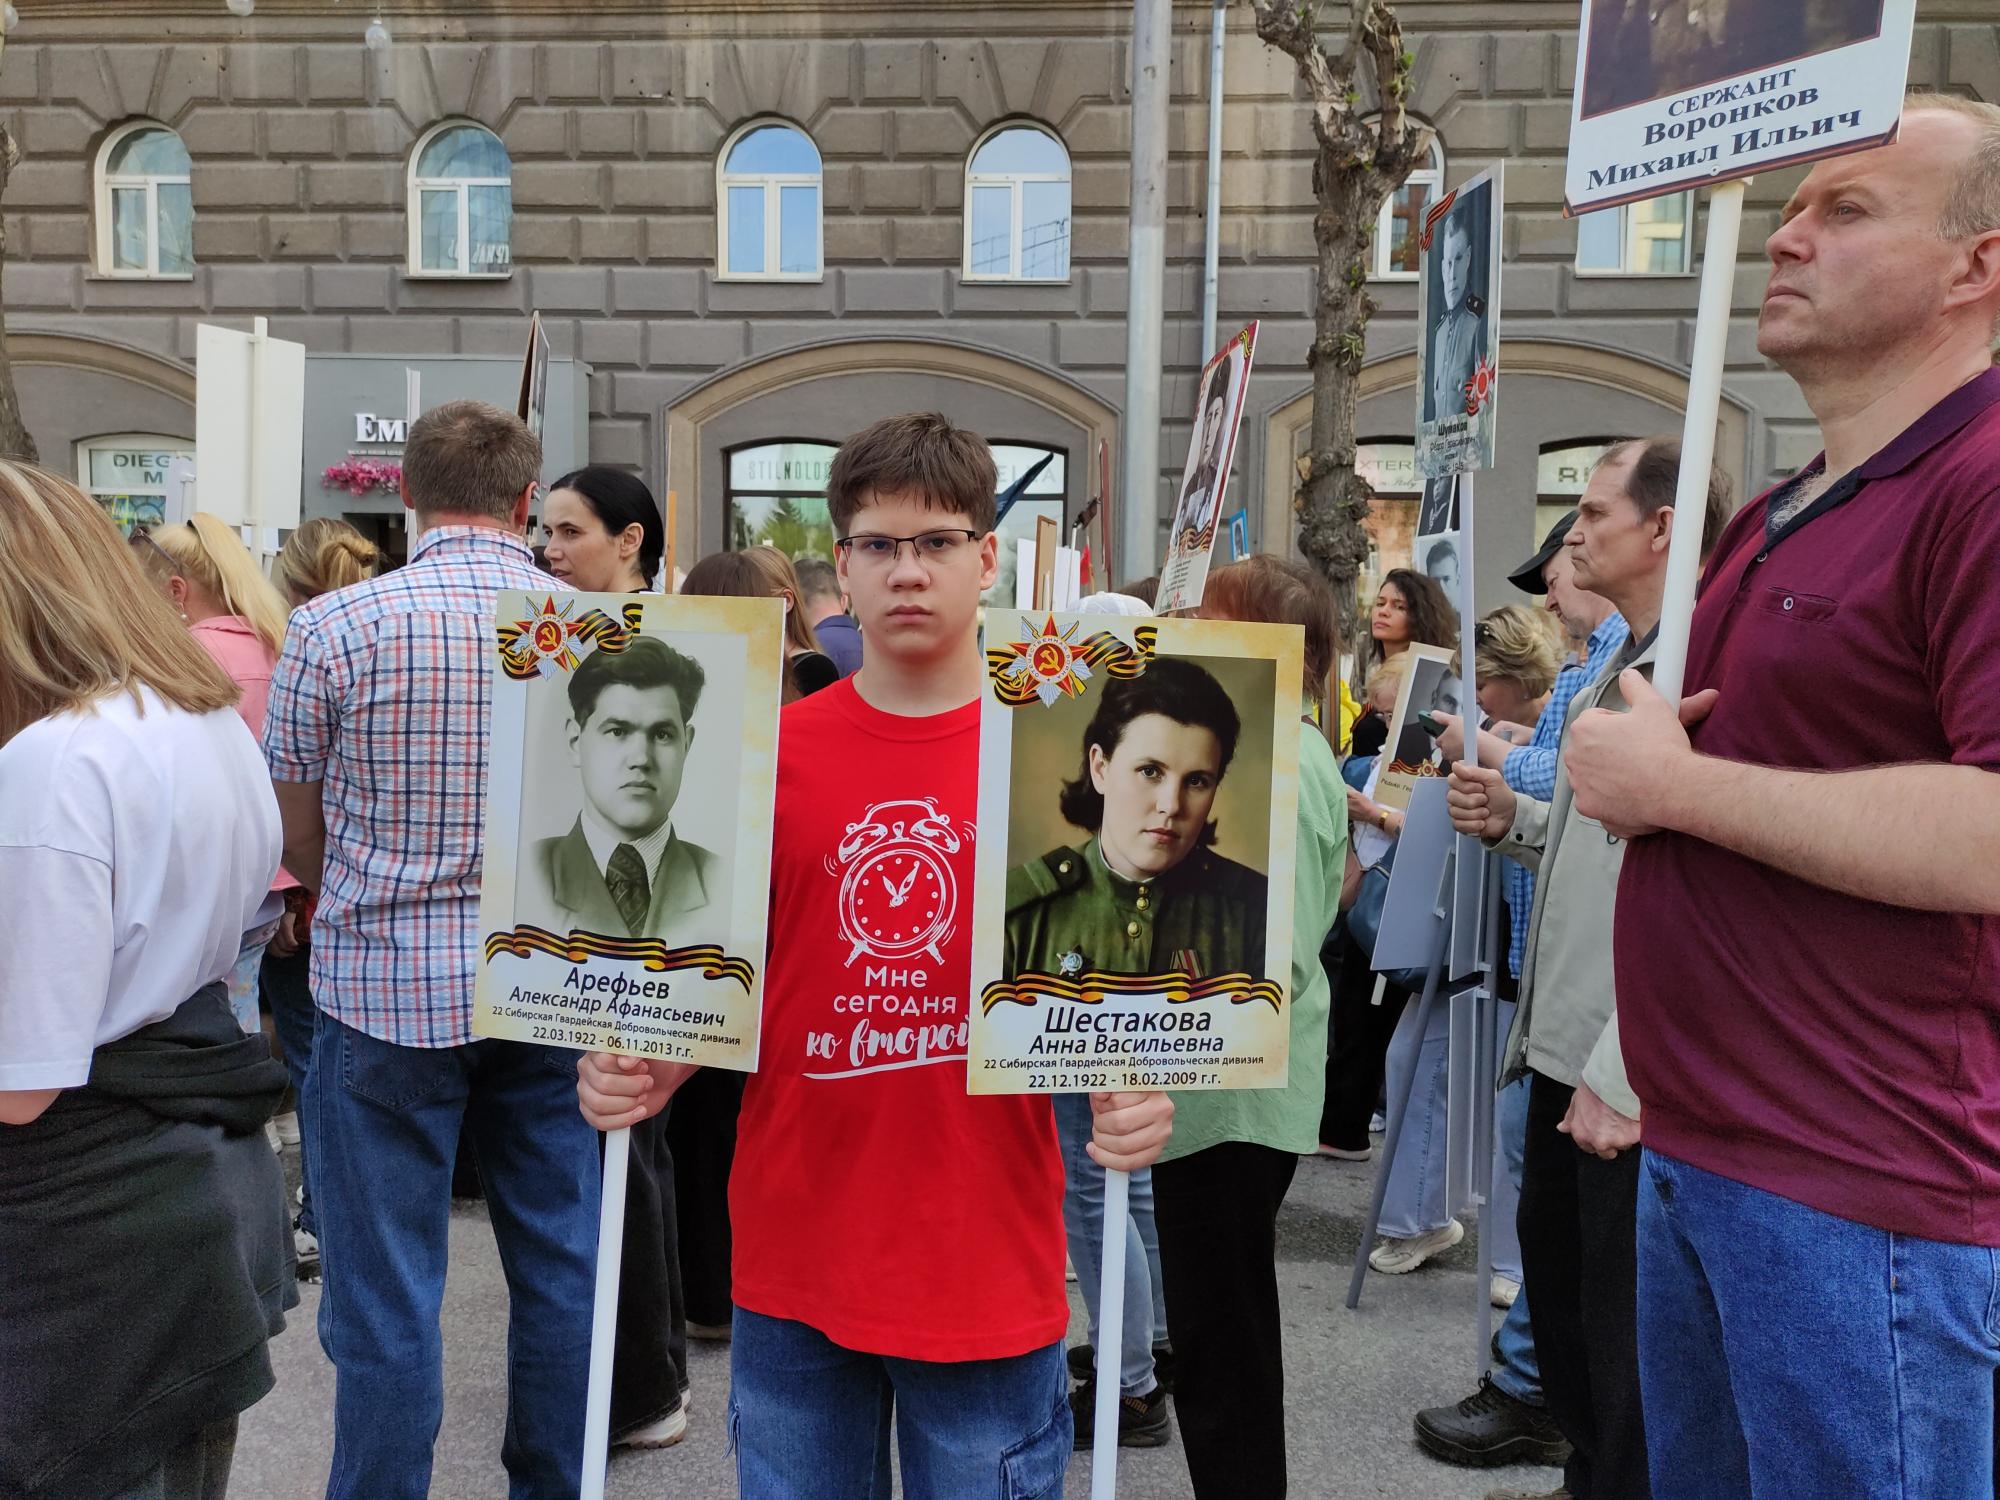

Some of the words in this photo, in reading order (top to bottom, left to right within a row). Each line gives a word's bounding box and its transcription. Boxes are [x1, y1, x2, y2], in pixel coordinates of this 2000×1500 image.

[1667, 68, 1797, 118] СЕРЖАНТ
[1641, 86, 1819, 147] Воронков
[1586, 143, 1719, 191] Михаил
[1726, 108, 1863, 156] Ильич
[113, 454, 192, 468] DIEG
[564, 967, 670, 1000] Арефьев
[865, 965, 928, 988] Мне
[509, 986, 602, 1016] Александр
[606, 995, 725, 1027] Афанасьевич
[833, 994, 957, 1017] сегодня
[492, 1006, 503, 1016] 22
[505, 1007, 553, 1022] Сибирская
[556, 1013, 613, 1029] Гвардейская
[614, 1020, 699, 1041] Добровольческая
[700, 1033, 741, 1046] дивизия
[1045, 1006, 1212, 1034] Шестакова
[533, 1026, 596, 1046] 22.03.1922
[607, 1036, 672, 1056] 06.11.2013
[675, 1047, 694, 1058] г.г.
[806, 1031, 842, 1059] ко
[1029, 1034, 1086, 1055] Анна
[1094, 1033, 1224, 1054] Васильевна
[984, 1059, 997, 1069] 22
[999, 1058, 1057, 1071] Сибирская
[1060, 1057, 1126, 1069] Гвардейская
[1128, 1055, 1220, 1068] Добровольческая
[1222, 1056, 1264, 1066] дивизия
[1029, 1074, 1107, 1088] 22.12.1922
[1122, 1072, 1197, 1086] 18.02.2009
[1201, 1075, 1221, 1085] г.г.
